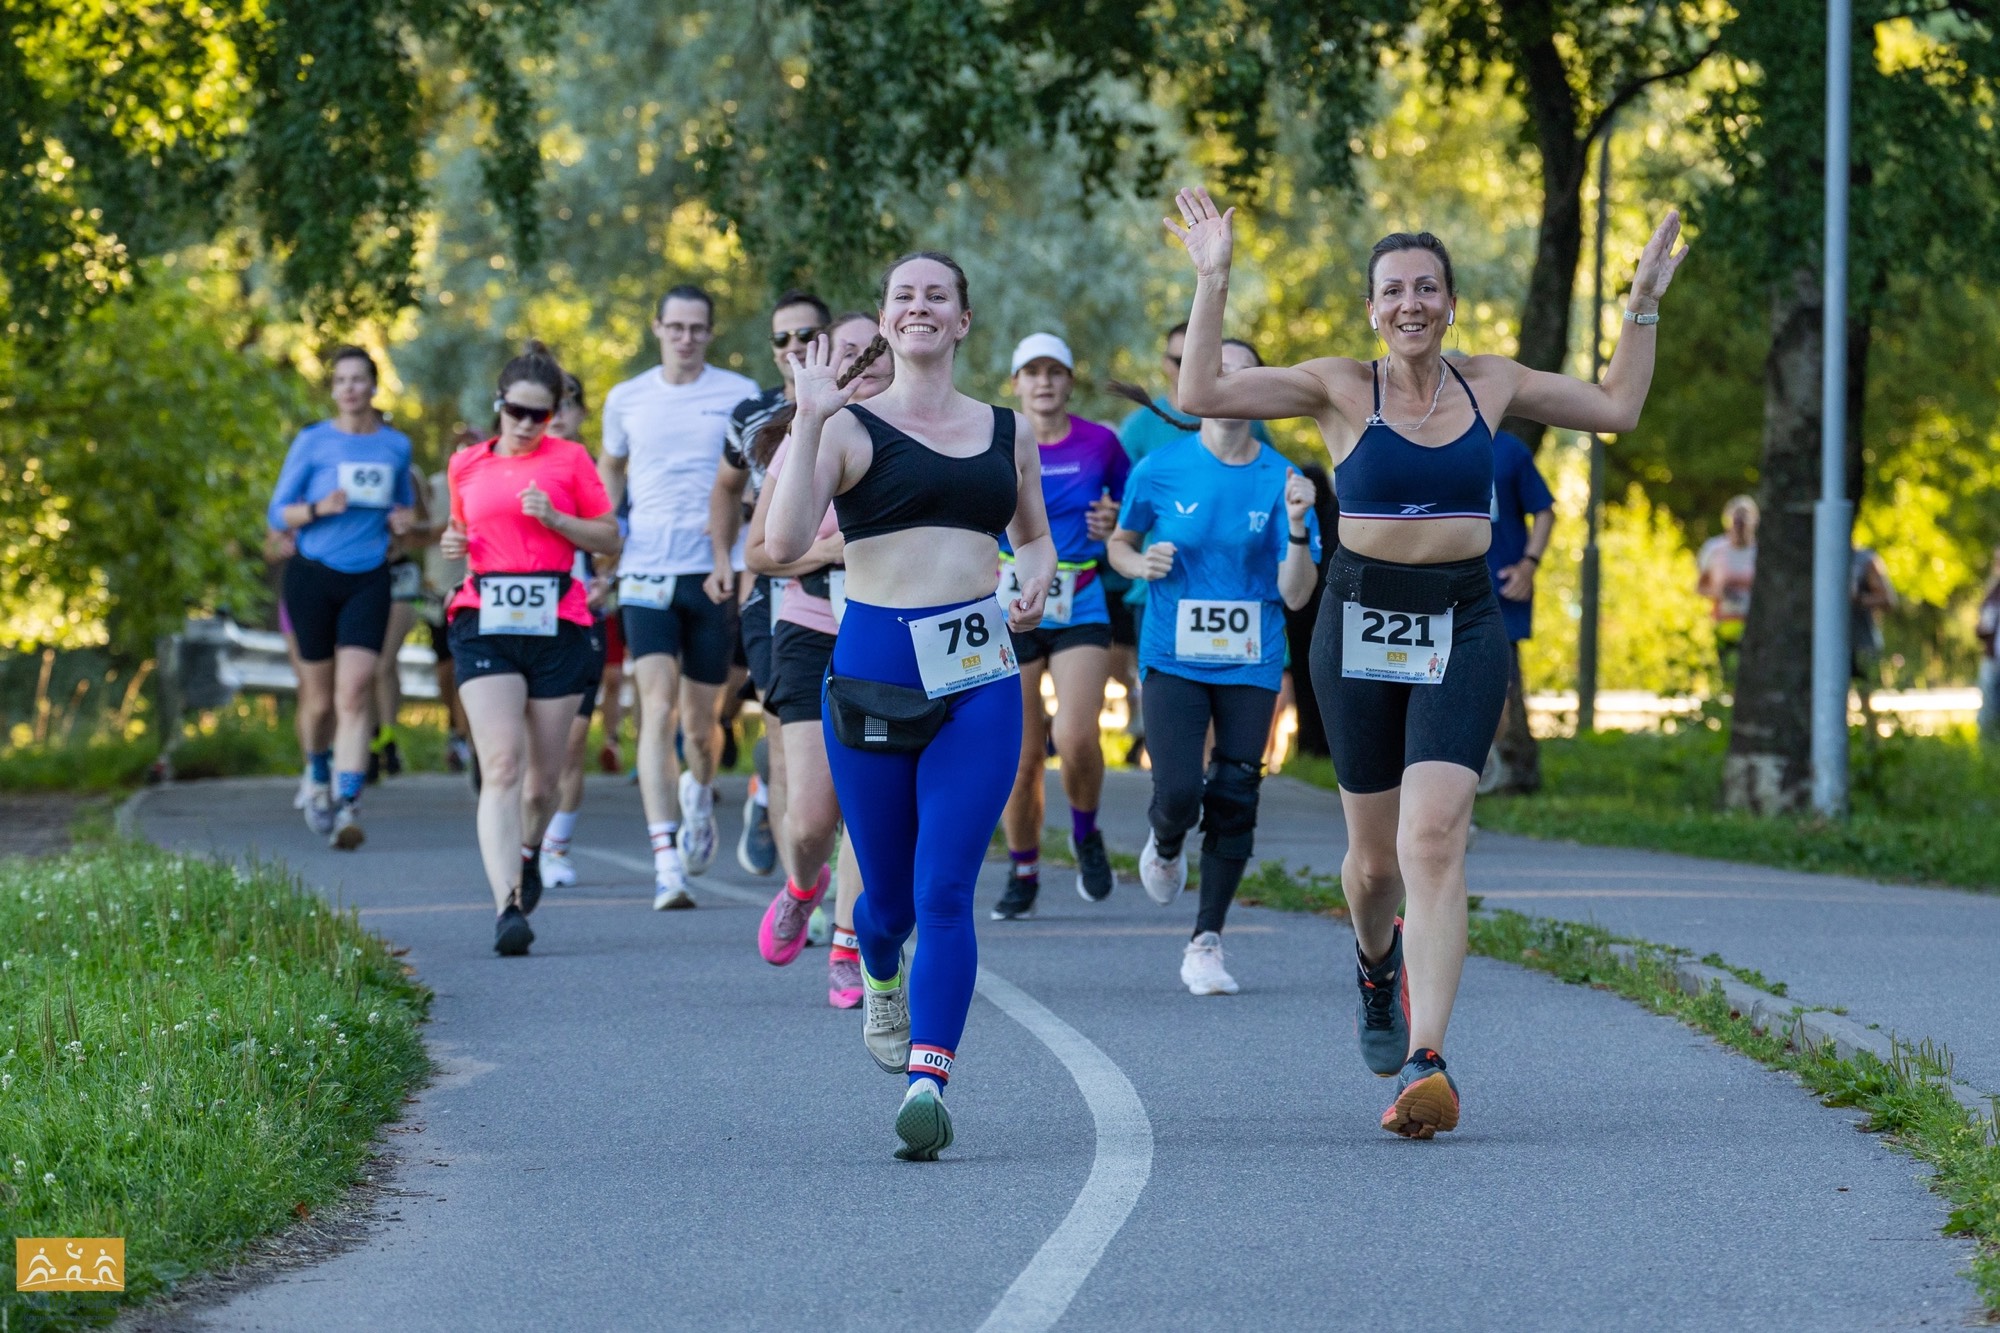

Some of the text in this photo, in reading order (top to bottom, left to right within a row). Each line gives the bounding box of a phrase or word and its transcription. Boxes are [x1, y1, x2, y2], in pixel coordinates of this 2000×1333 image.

[491, 584, 546, 608] 105
[1009, 572, 1062, 597] 18
[938, 612, 990, 655] 78
[1190, 607, 1249, 634] 150
[1361, 610, 1435, 648] 221
